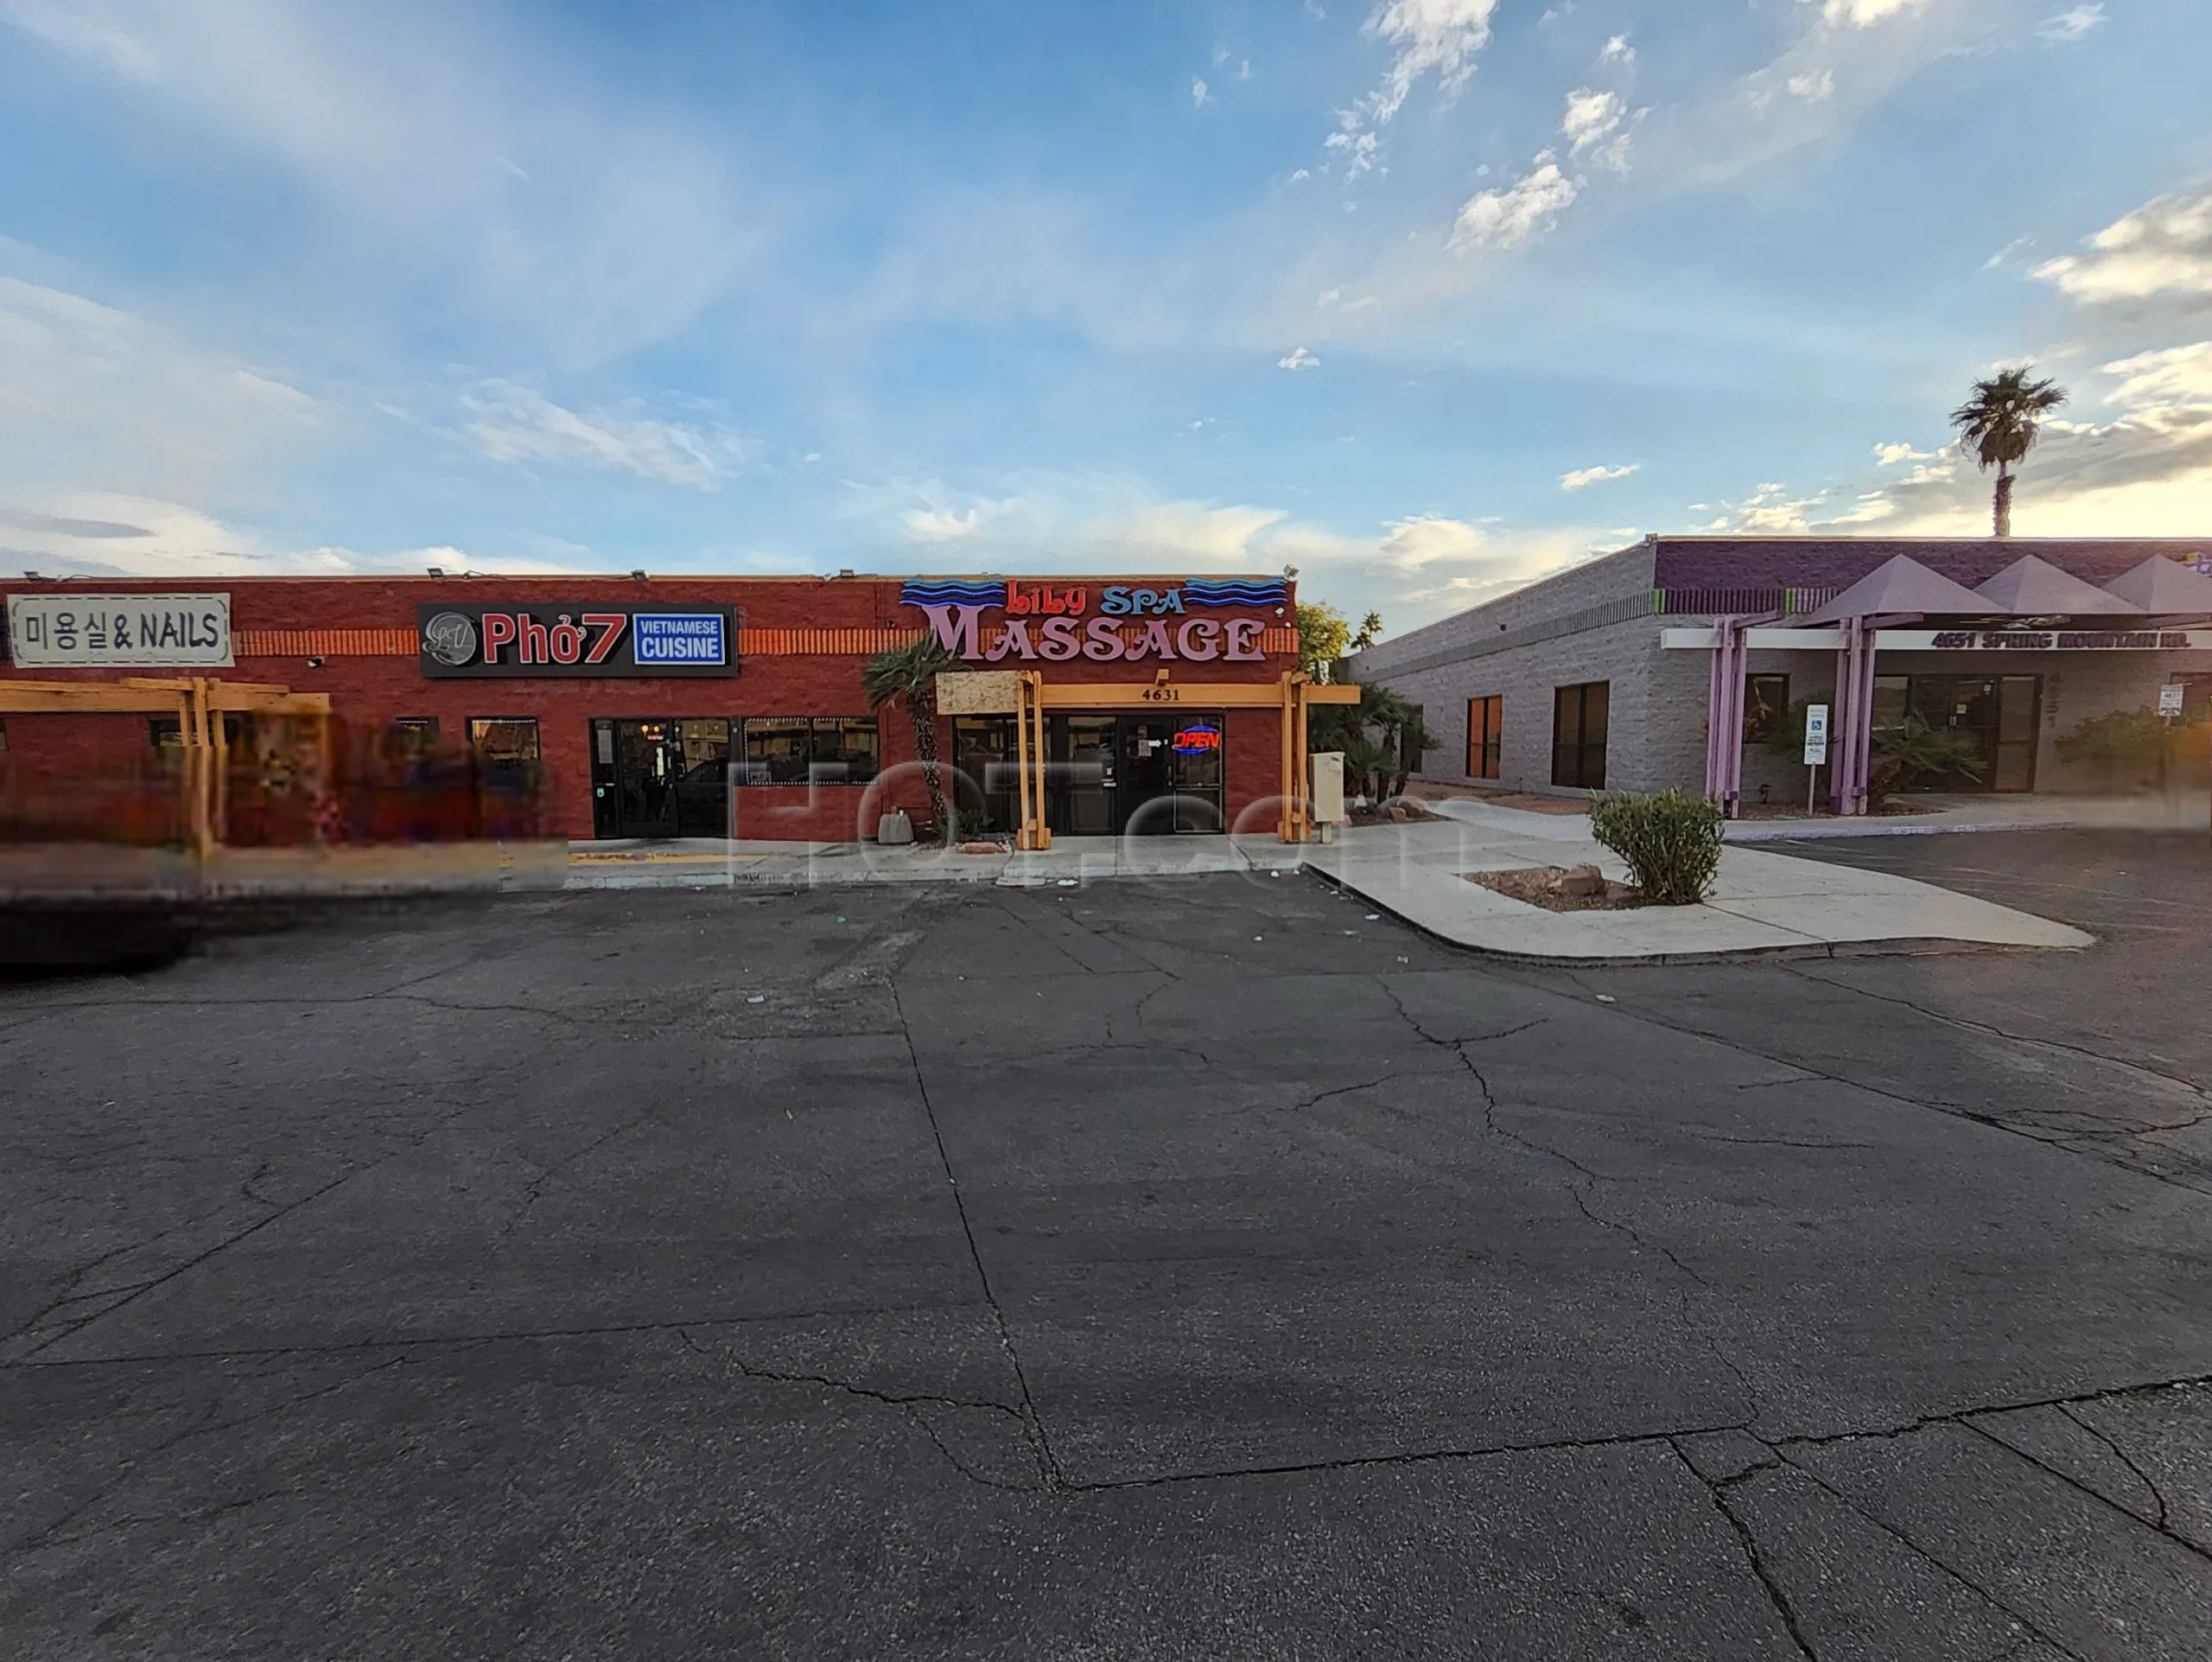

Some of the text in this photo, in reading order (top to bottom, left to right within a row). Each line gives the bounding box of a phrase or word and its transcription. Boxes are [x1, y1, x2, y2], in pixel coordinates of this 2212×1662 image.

[140, 611, 219, 649] NAILS
[640, 620, 718, 635] VIETNAMESE
[921, 603, 1267, 662] MASSAGE
[641, 635, 719, 659] CUISINE
[1931, 632, 1975, 648] 4651
[1981, 632, 2053, 648] SPRING
[2056, 632, 2158, 648] MOUNTAIN
[1141, 689, 1179, 701] 4631
[1174, 732, 1220, 748] OPEN
